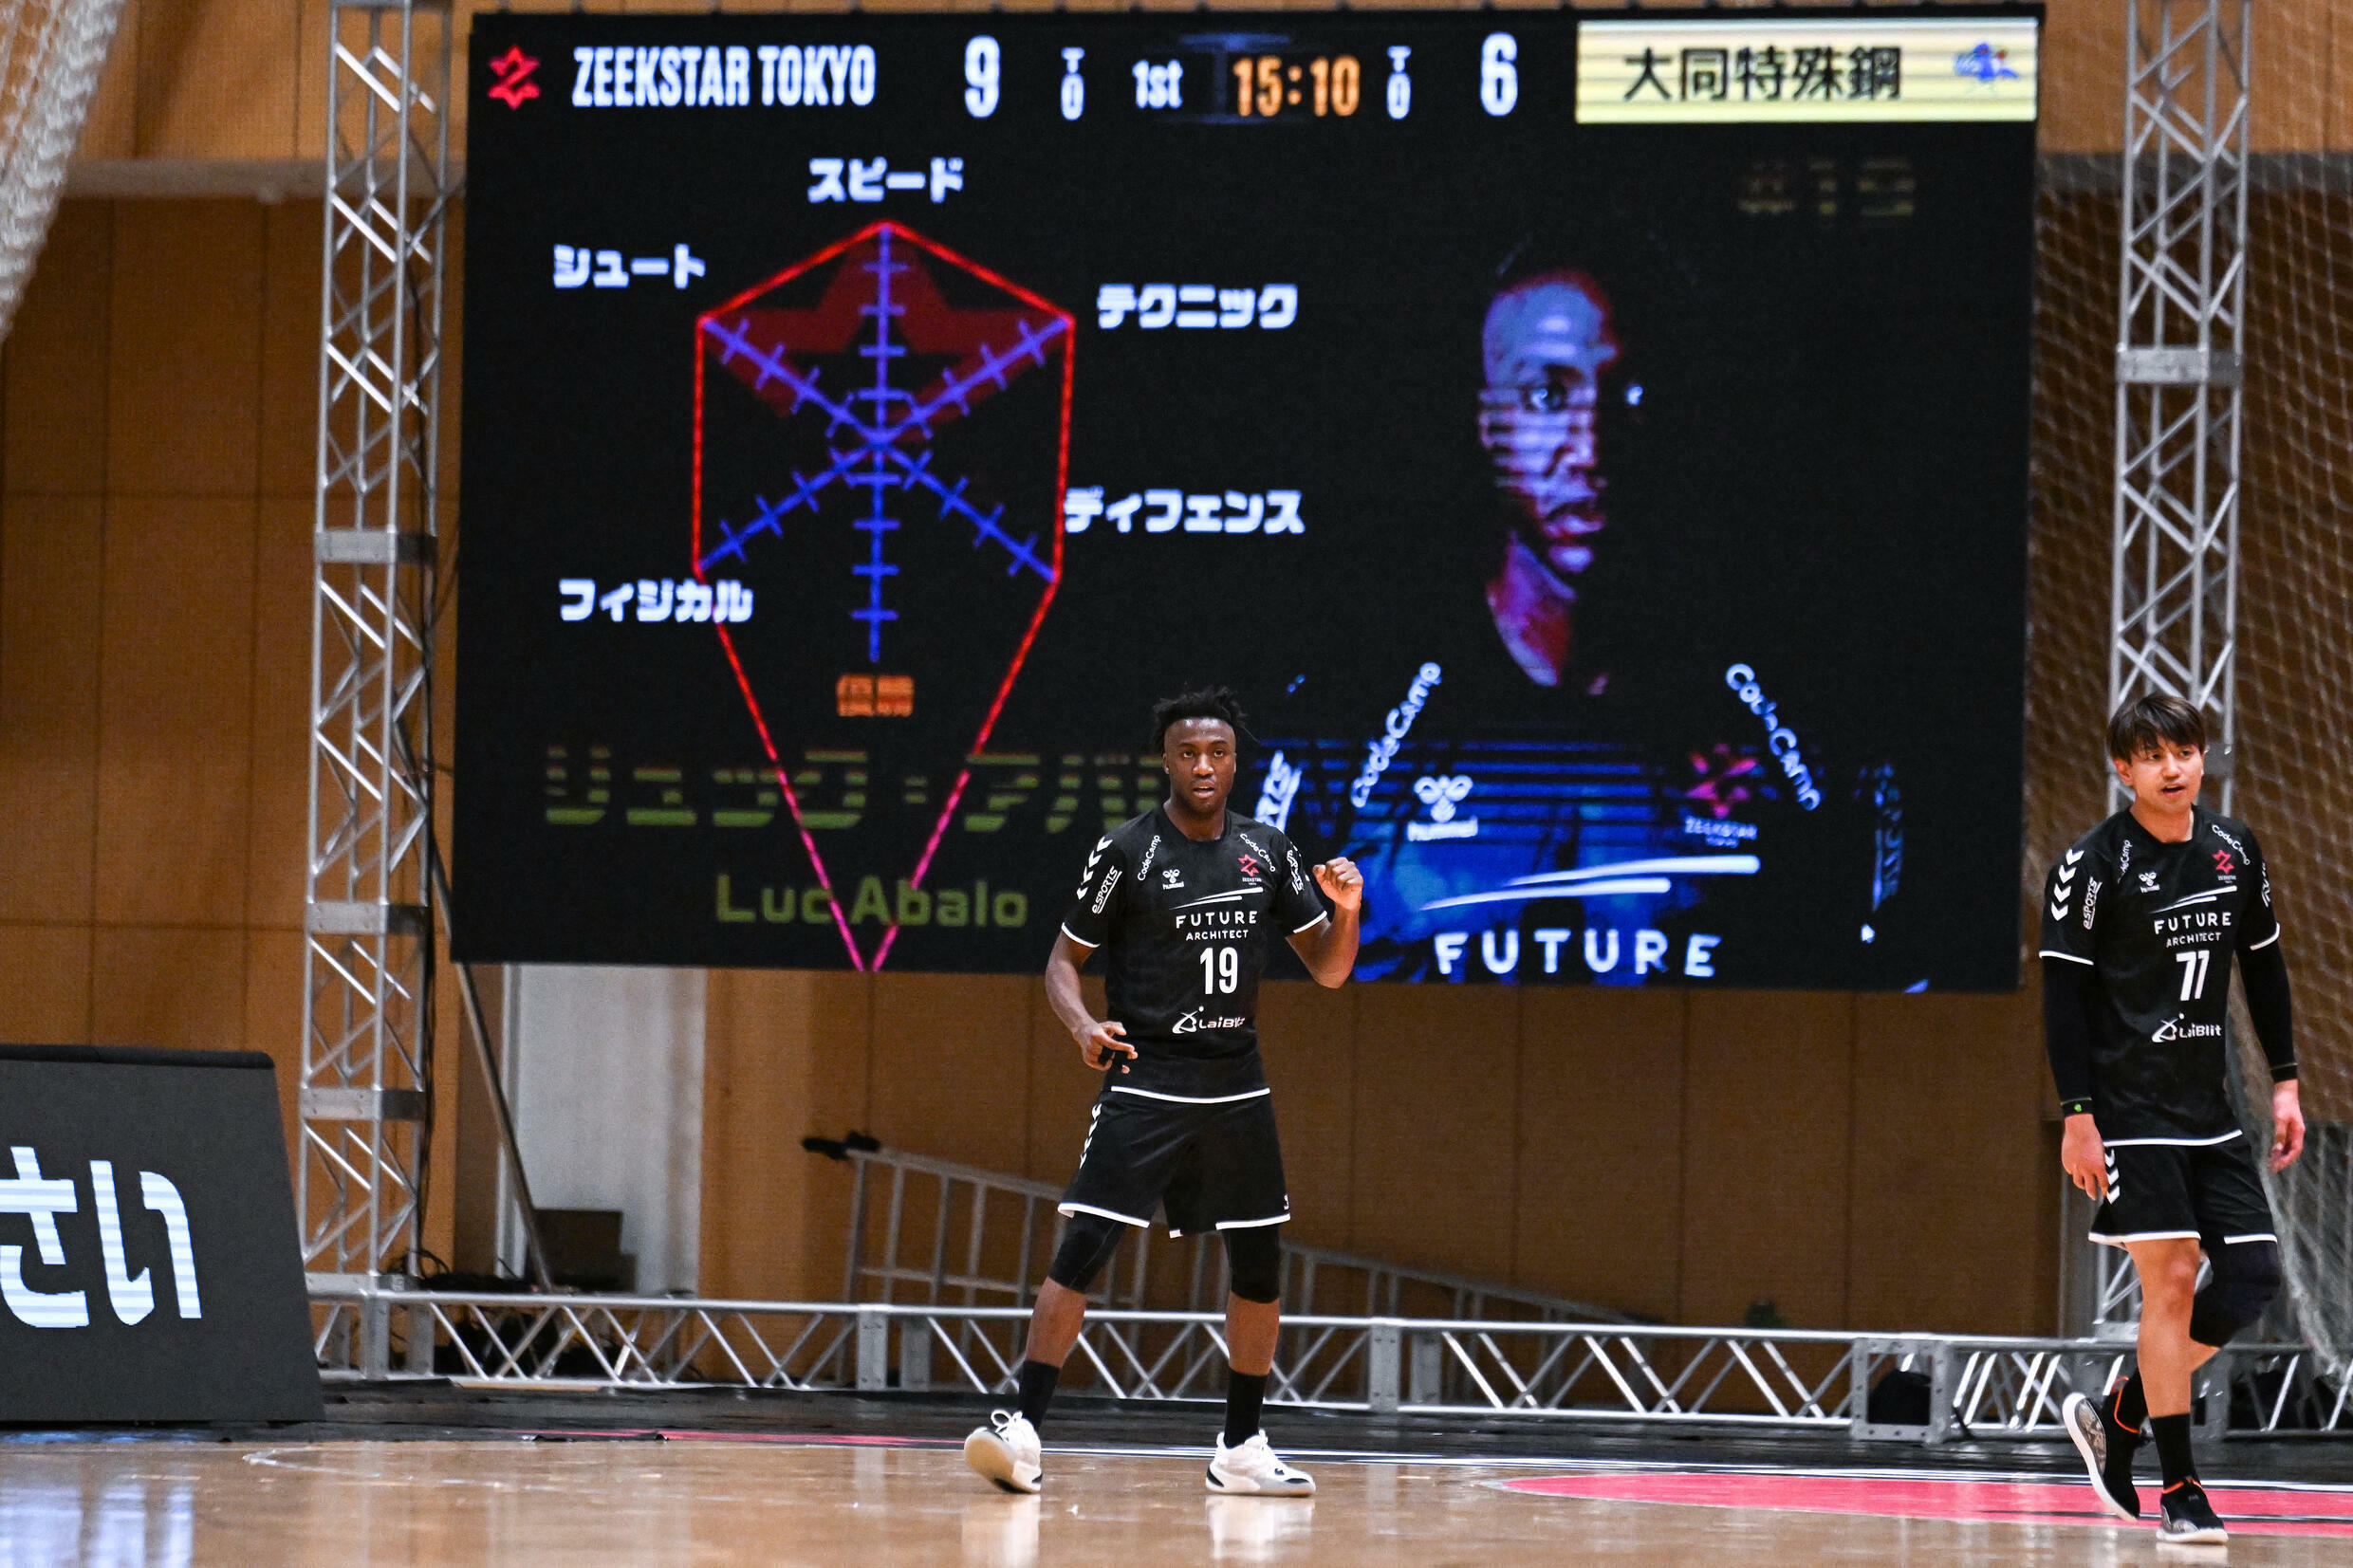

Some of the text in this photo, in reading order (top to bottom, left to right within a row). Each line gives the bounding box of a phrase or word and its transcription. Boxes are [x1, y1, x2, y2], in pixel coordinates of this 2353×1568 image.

[571, 44, 878, 108] ZEEKSTAR TOKYO
[964, 34, 1002, 120] 9
[1132, 59, 1183, 110] 1st
[1233, 55, 1361, 118] 15:10
[1479, 31, 1519, 118] 6
[1622, 46, 1900, 101] 大同特殊鋼
[806, 156, 965, 204] スピード
[552, 243, 707, 290] シュート
[1096, 283, 1299, 330] テクニック
[1064, 486, 1306, 535] ディフェンス
[558, 579, 754, 623] フィジカル
[1137, 835, 1162, 881] CodeCamp
[716, 875, 1028, 928] Luc Abalo
[1176, 911, 1258, 929] FUTURE
[2154, 912, 2232, 934] FUTURE
[1185, 930, 1249, 941] ARCHITECT
[1434, 928, 1722, 978] FUTURE
[2165, 932, 2222, 948] ARCHITECT
[1199, 947, 1238, 995] 19
[2176, 950, 2211, 1002] 77
